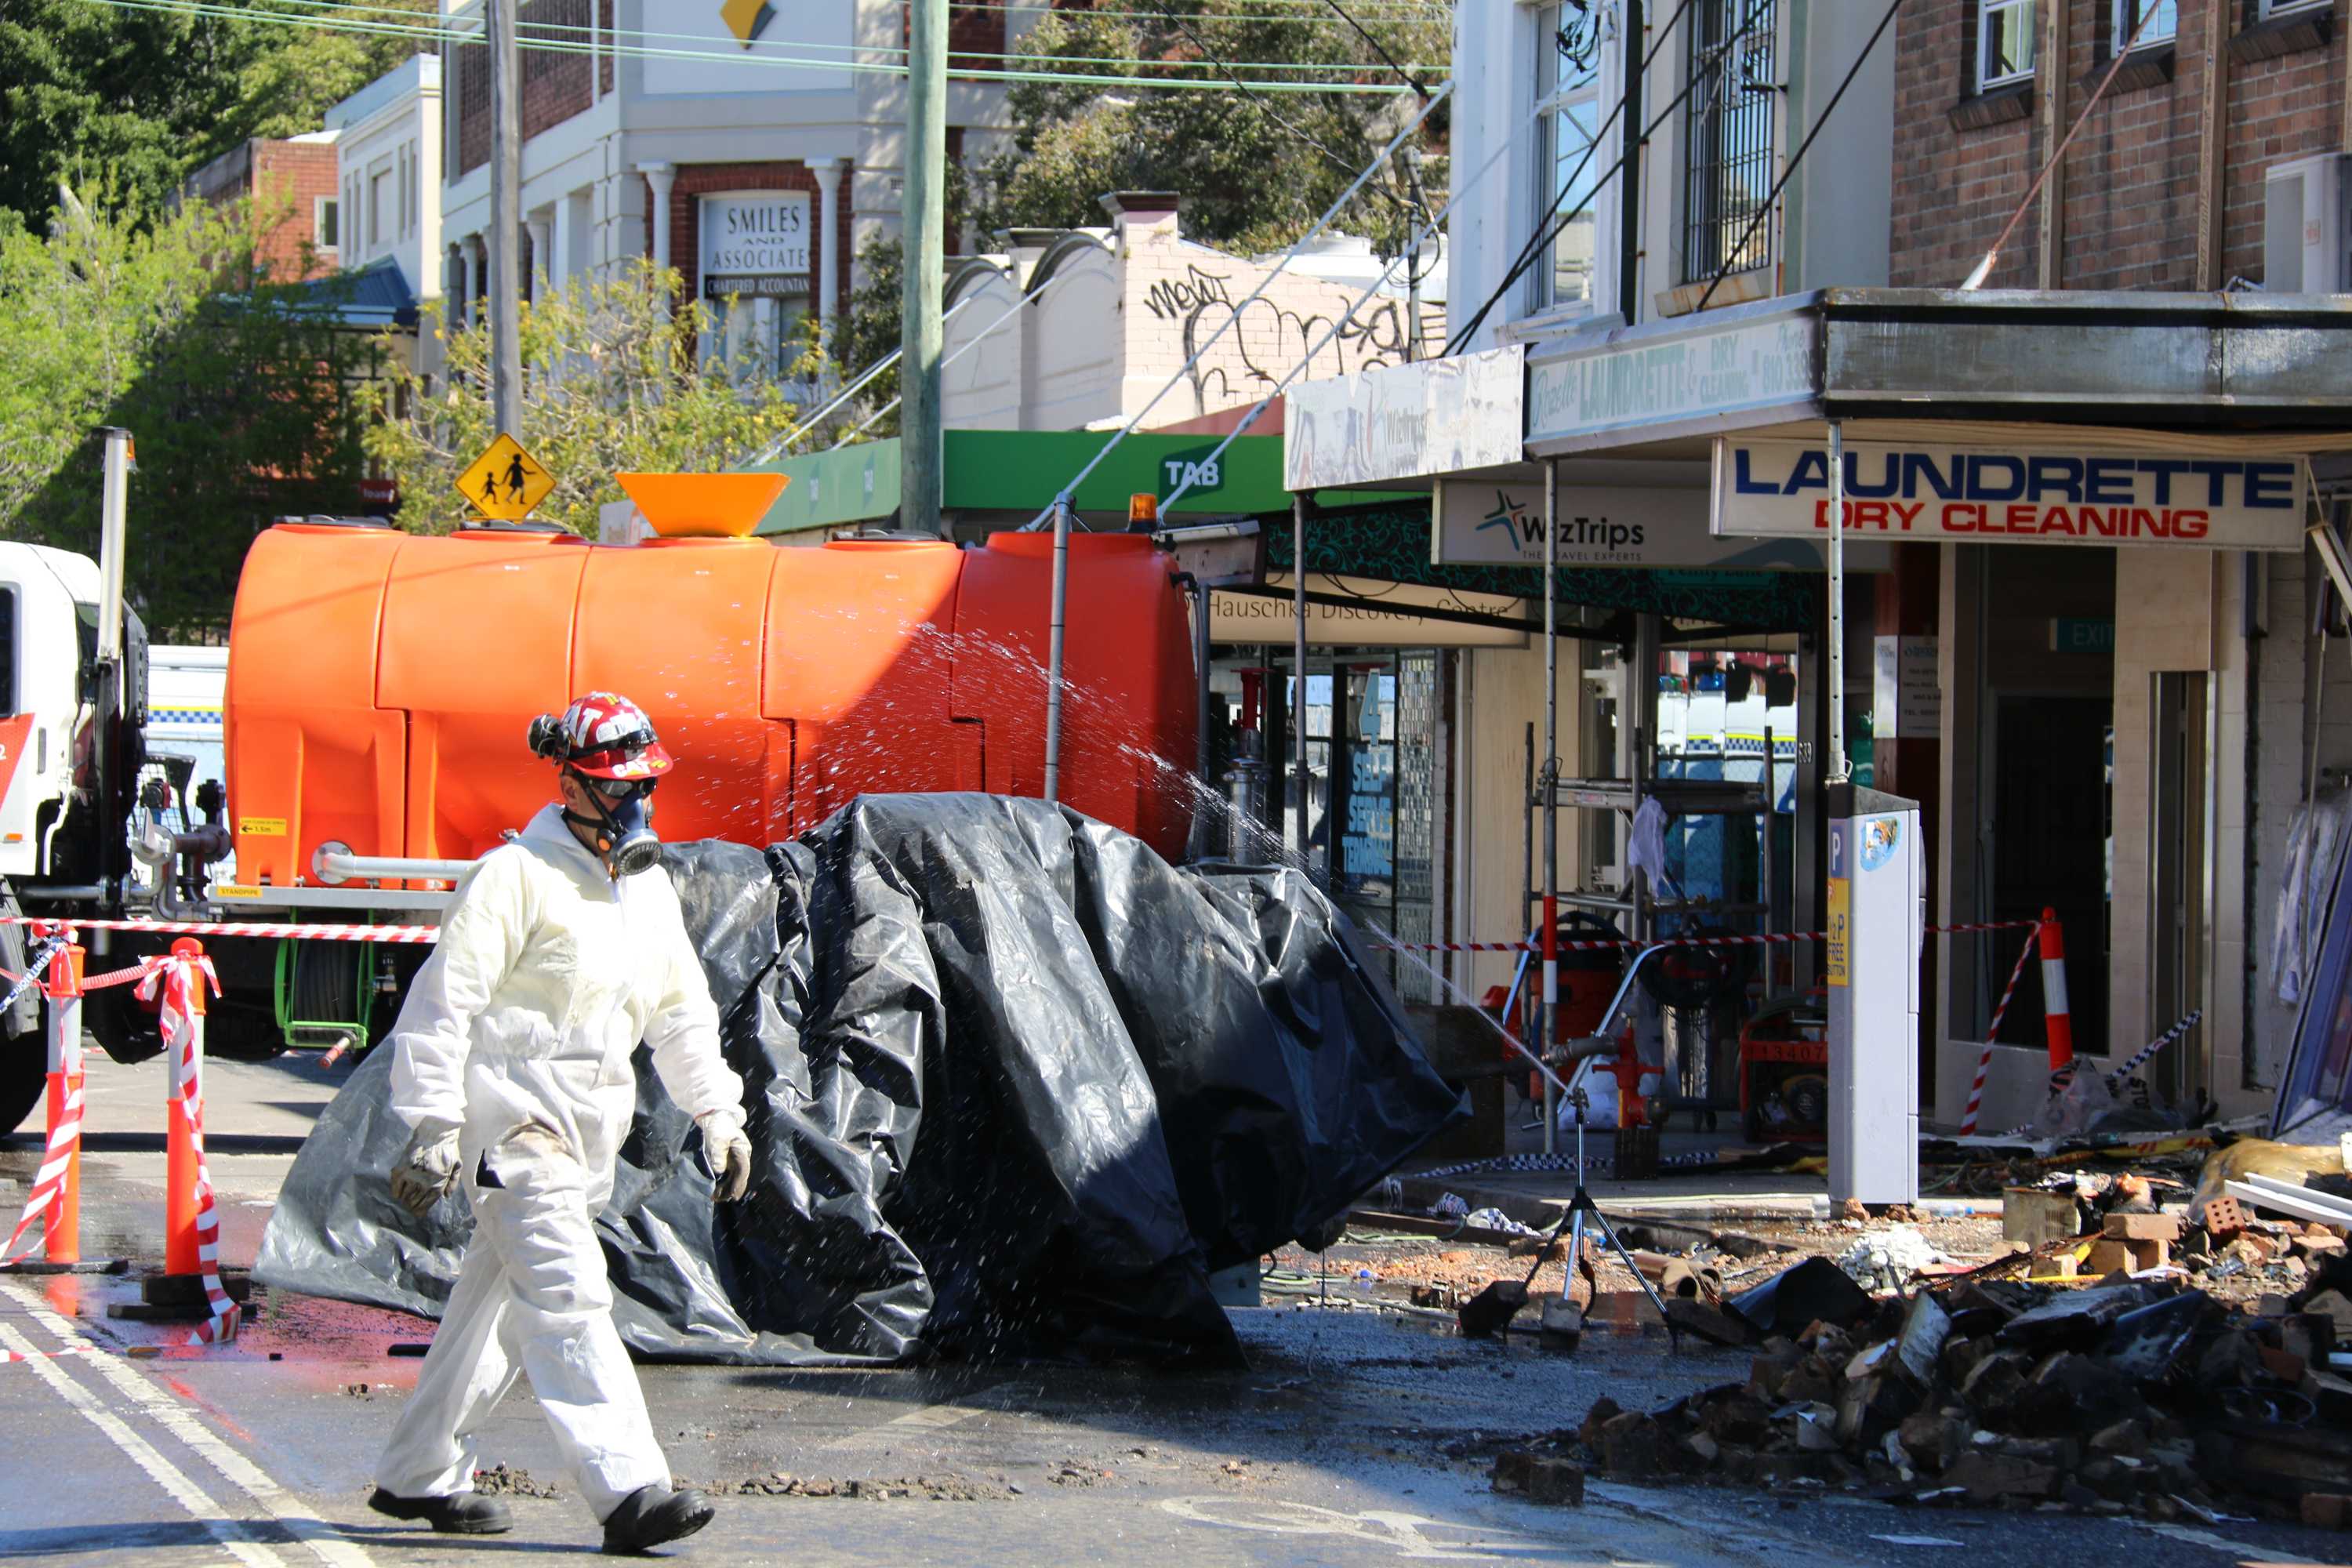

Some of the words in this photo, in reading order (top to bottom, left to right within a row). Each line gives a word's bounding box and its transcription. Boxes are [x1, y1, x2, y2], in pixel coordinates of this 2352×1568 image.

[728, 206, 800, 234] SMILES
[742, 237, 785, 245] AND
[707, 278, 755, 293] CHARTERED
[1711, 333, 1739, 372] DRY
[1580, 343, 1686, 421] LAUNDRETTE
[1700, 370, 1750, 405] CLEANING
[1165, 461, 1218, 486] TAB
[1735, 449, 2296, 510] LAUNDRETTE
[1521, 516, 1644, 550] WzTrips
[1814, 499, 1925, 532] DRY
[1940, 503, 2209, 539] CLEANING
[1523, 550, 1543, 560] THE
[1595, 552, 1642, 561] EXPERTS
[1831, 832, 1841, 871] P
[1828, 942, 1844, 962] FREE
